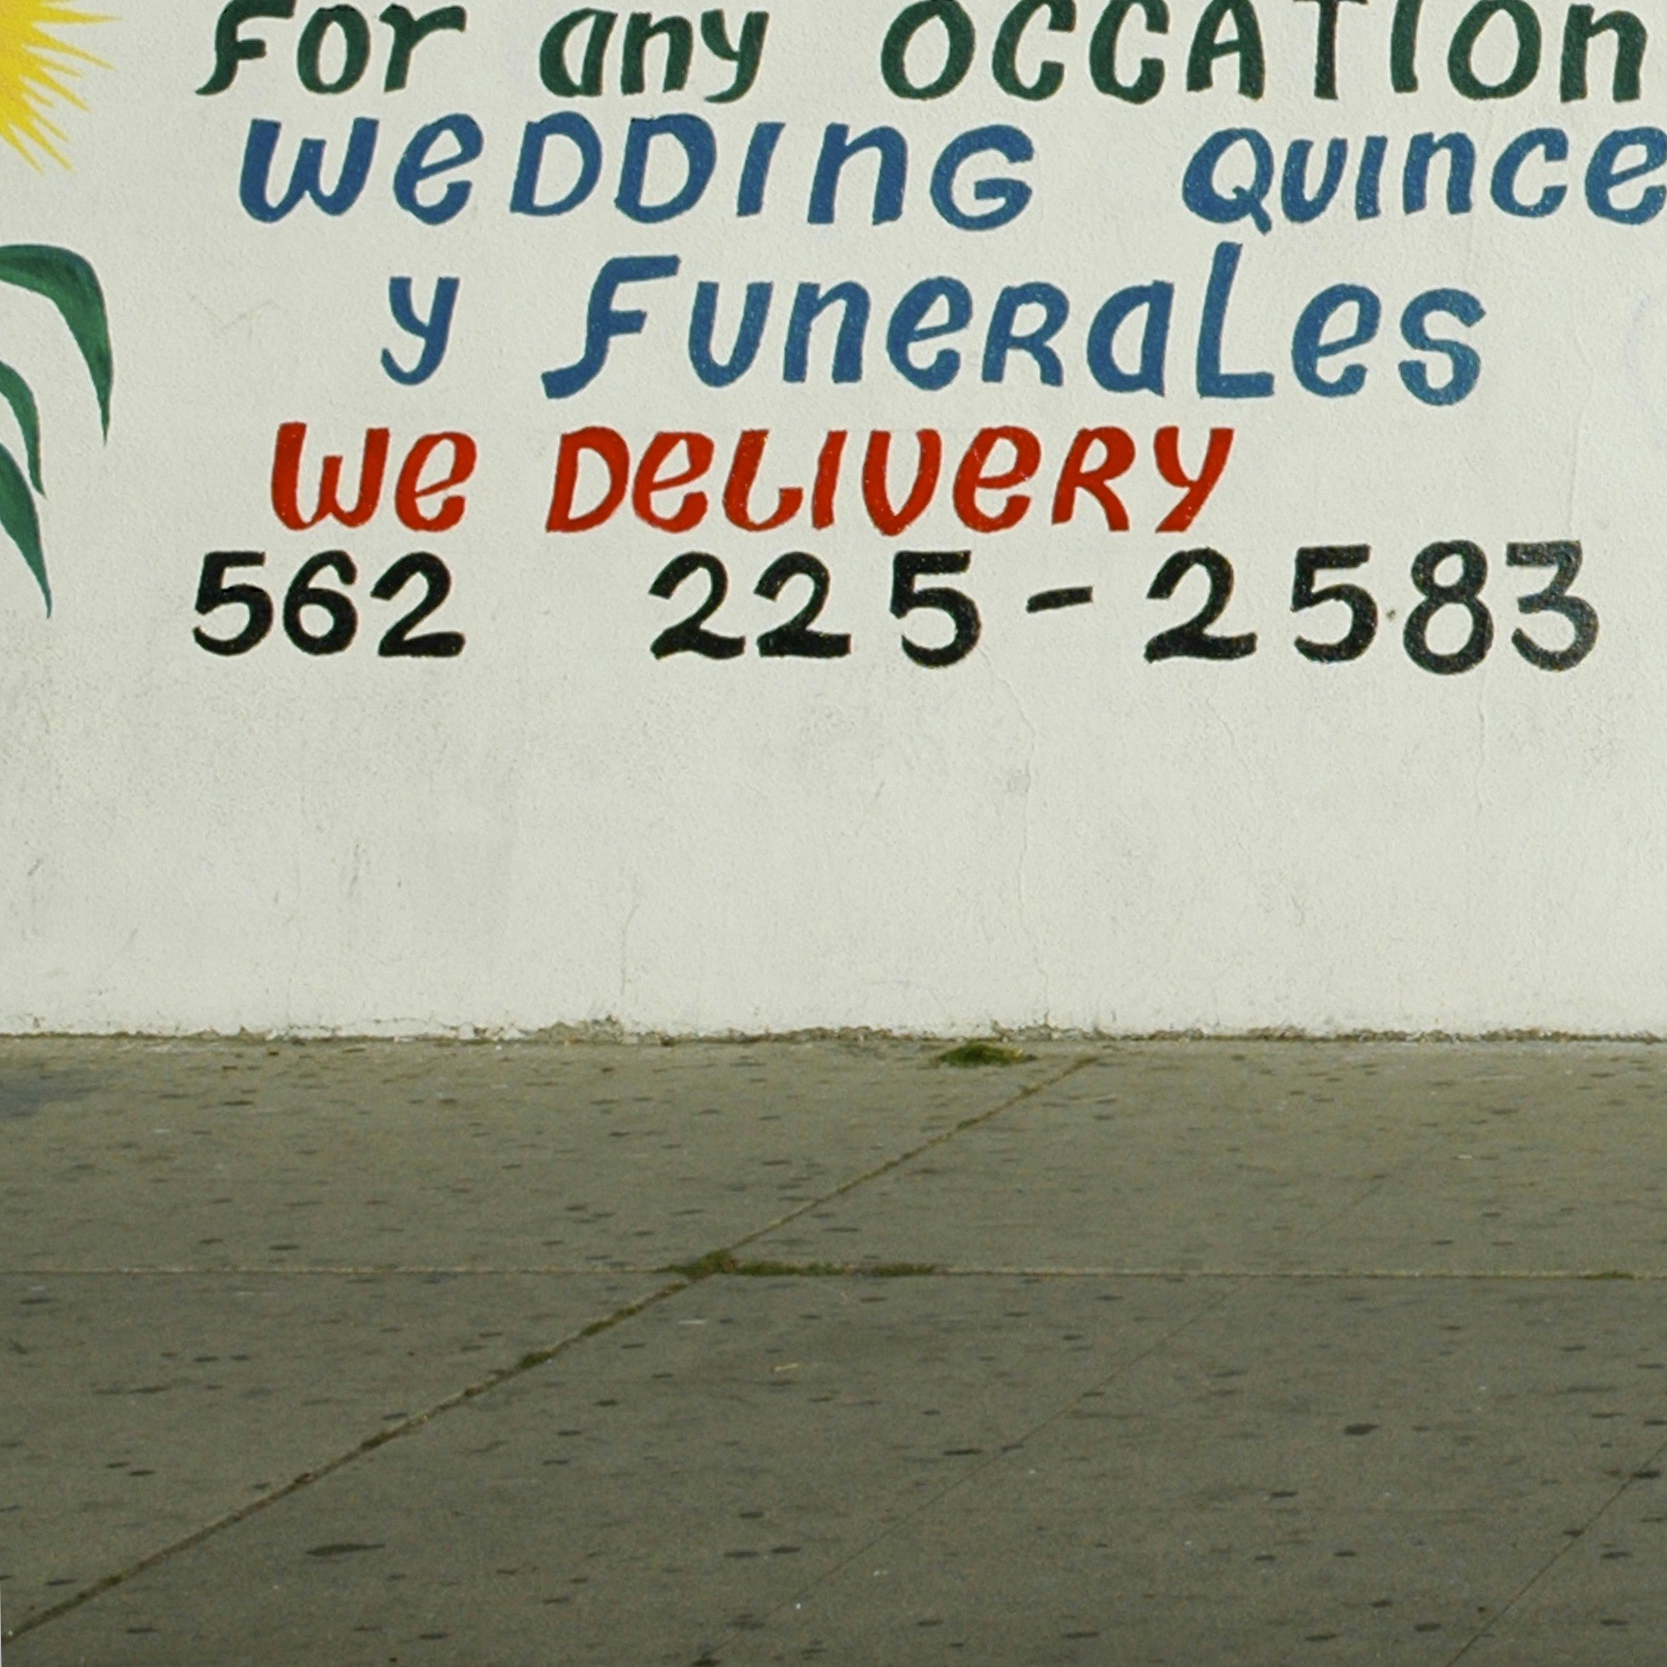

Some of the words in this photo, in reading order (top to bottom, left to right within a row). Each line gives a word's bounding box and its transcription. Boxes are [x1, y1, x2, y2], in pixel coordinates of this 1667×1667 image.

[540, 8, 769, 103] any
[193, 550, 465, 657] 562
[649, 541, 1597, 674] 225-2583
